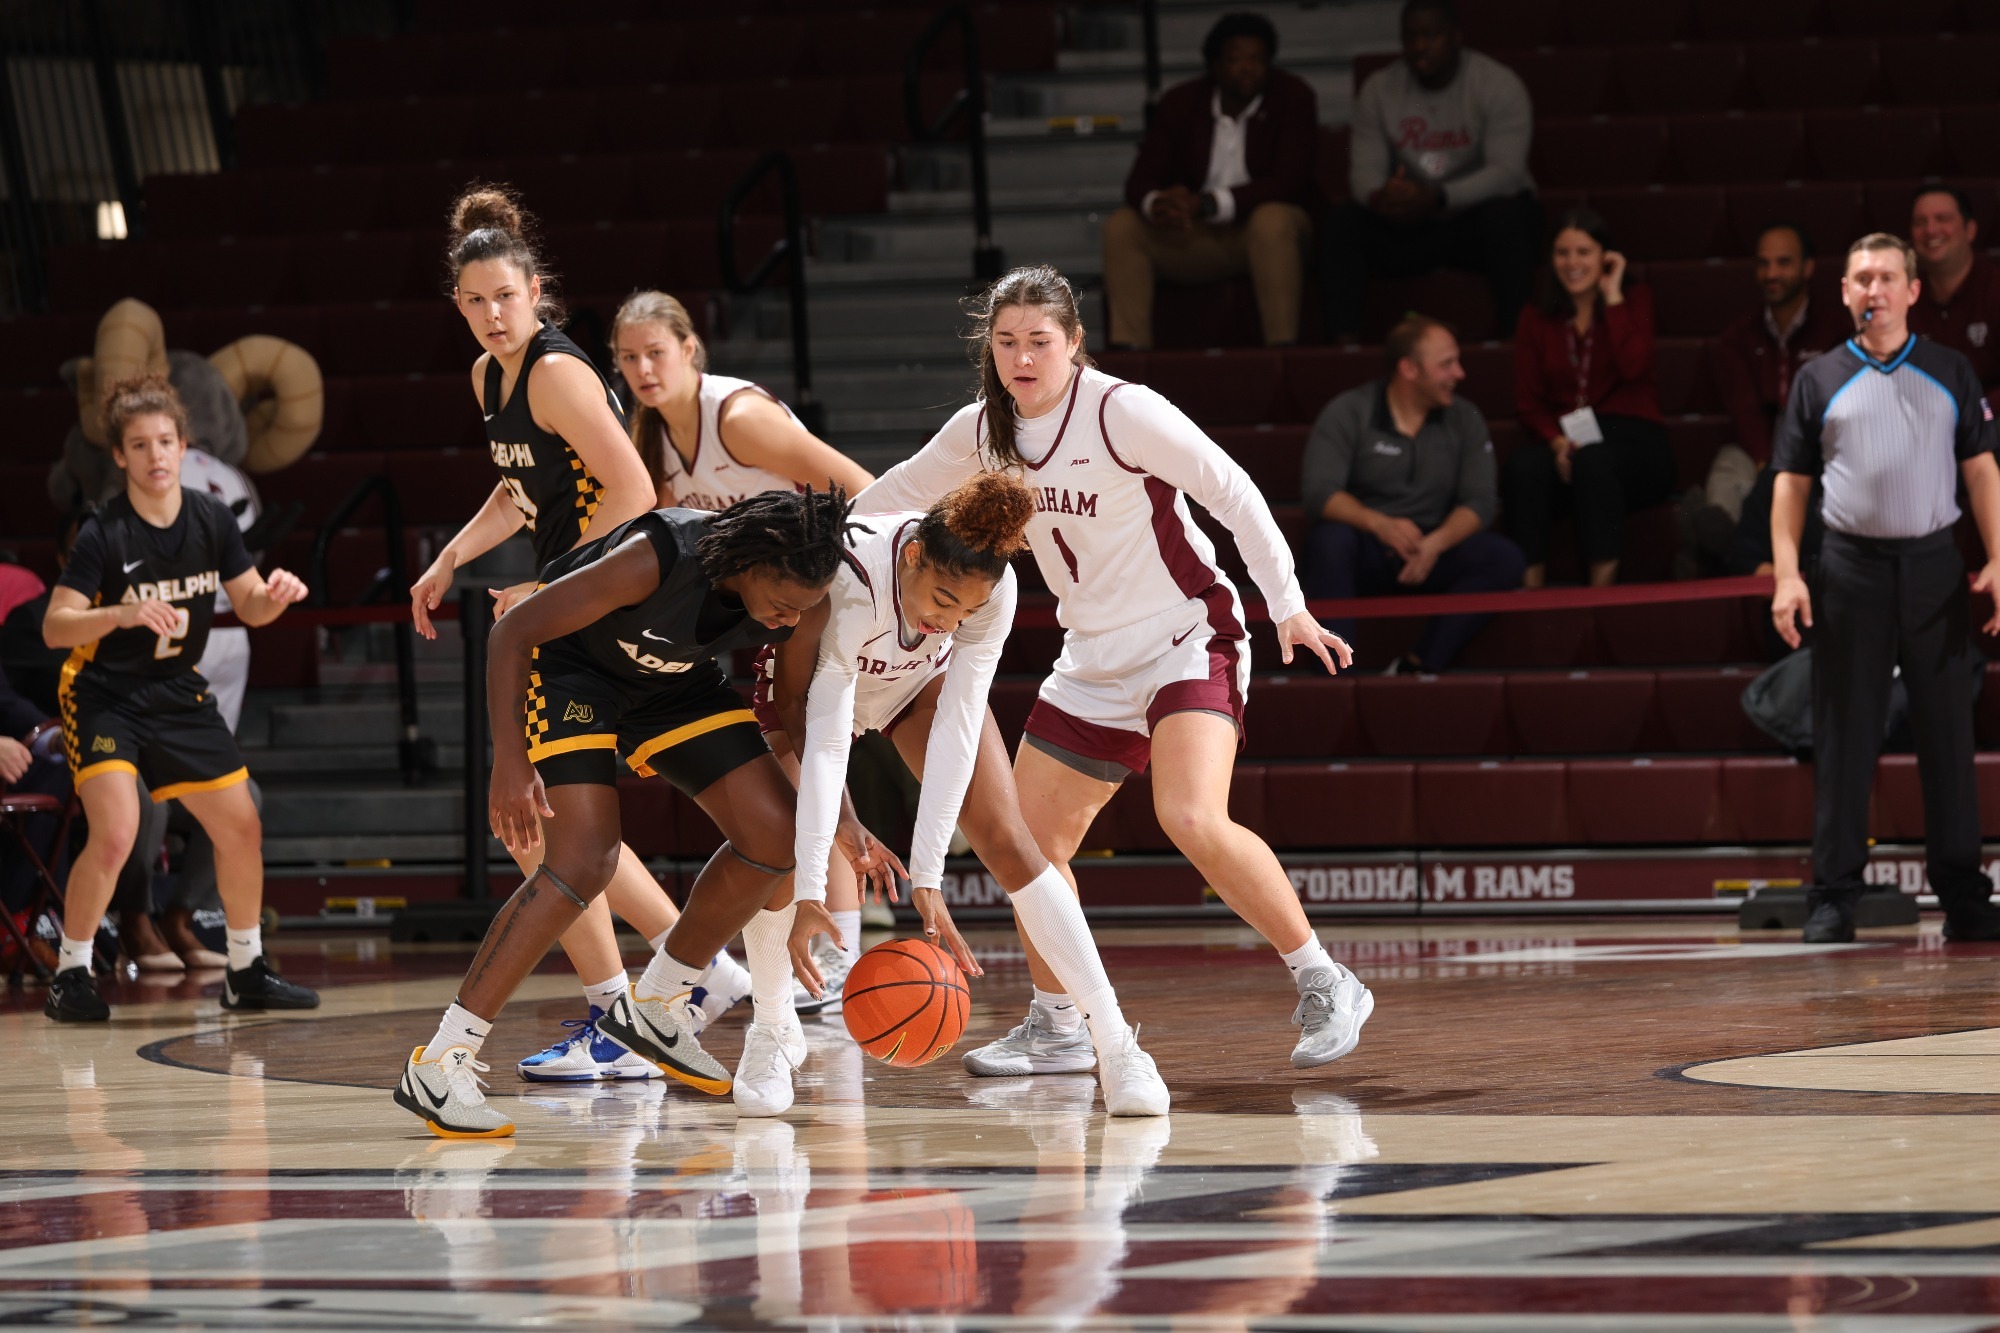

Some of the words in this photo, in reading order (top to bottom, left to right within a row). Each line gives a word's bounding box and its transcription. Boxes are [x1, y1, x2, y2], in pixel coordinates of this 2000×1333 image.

[1051, 527, 1080, 584] 1
[120, 570, 220, 604] ADELPHI
[941, 872, 1012, 906] RAM
[1287, 866, 1466, 901] FORDHAM
[1473, 865, 1575, 899] RAMS
